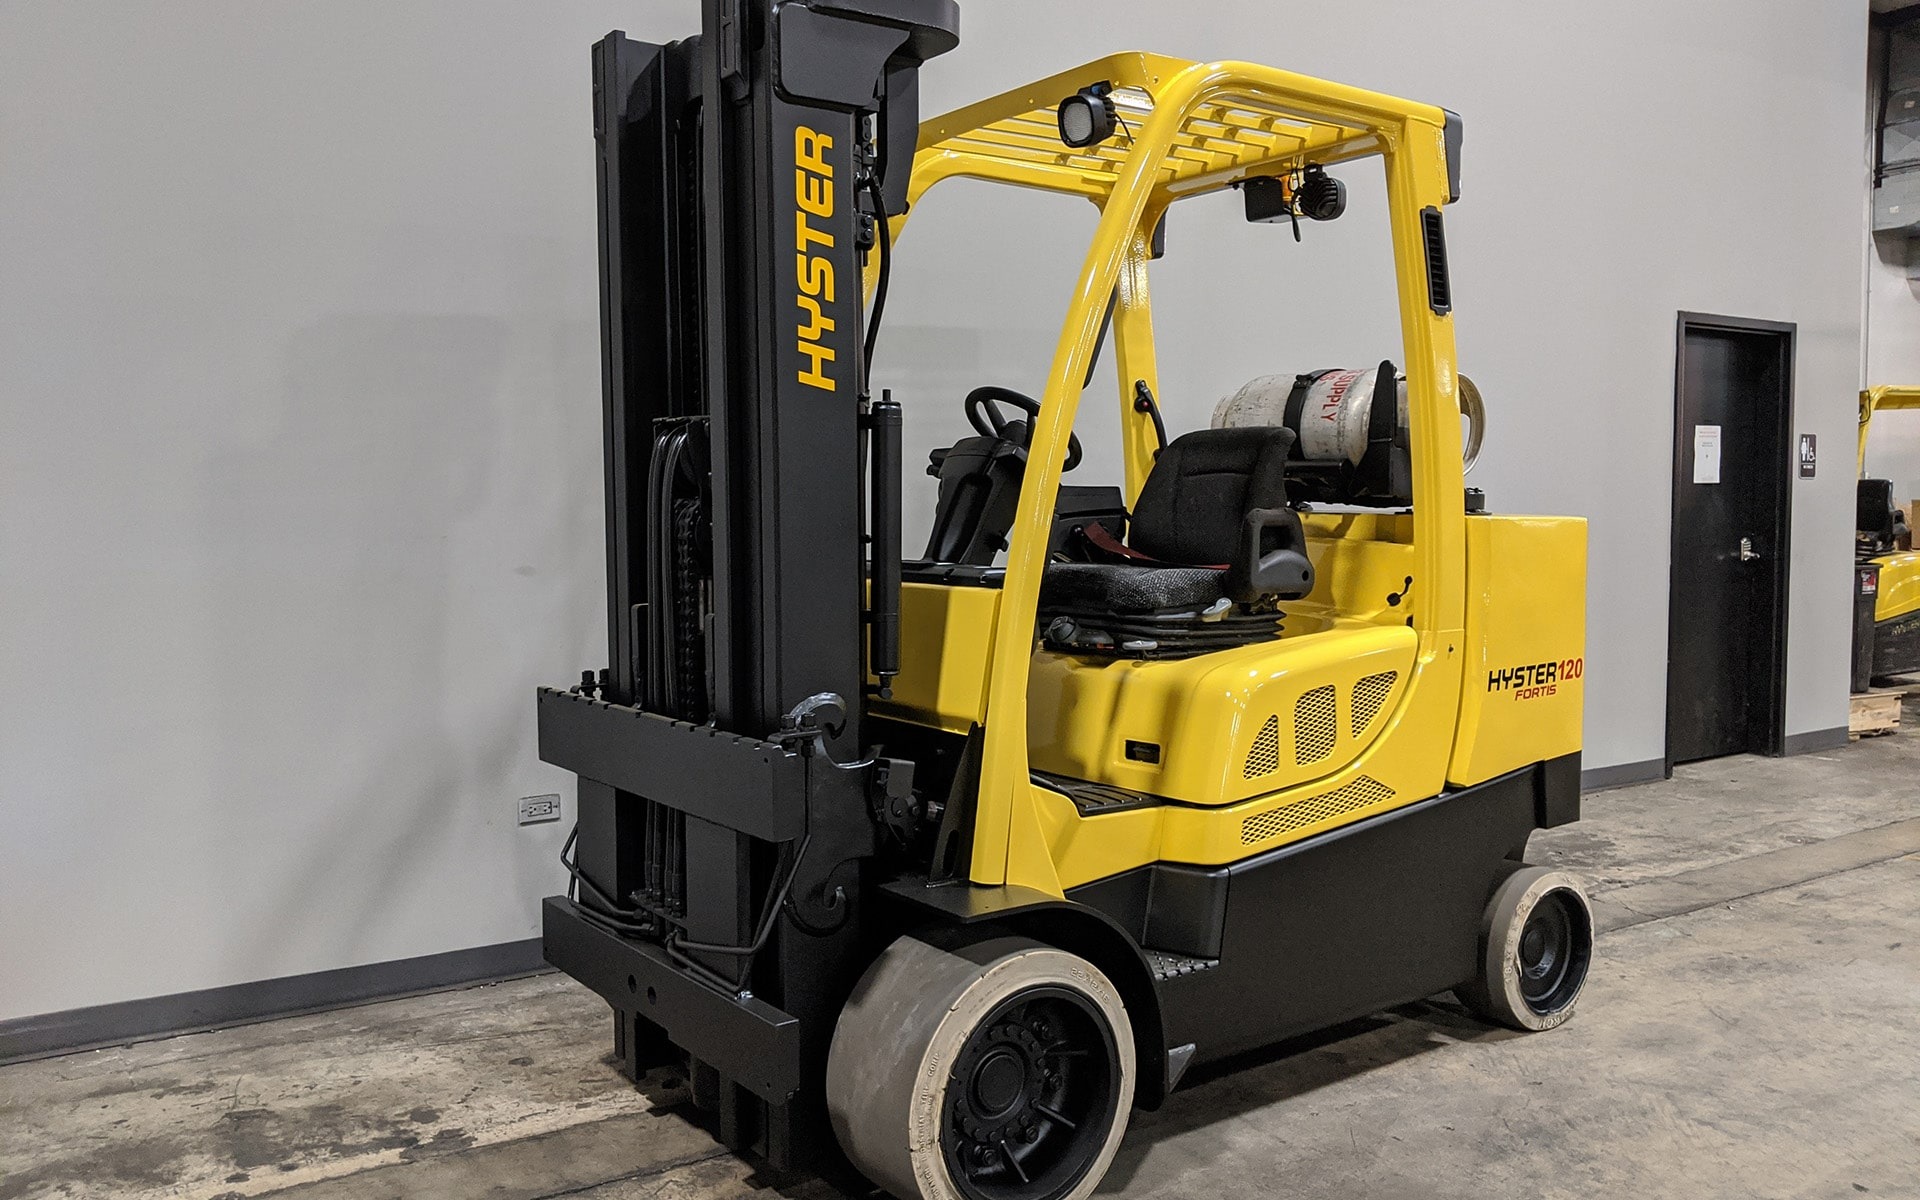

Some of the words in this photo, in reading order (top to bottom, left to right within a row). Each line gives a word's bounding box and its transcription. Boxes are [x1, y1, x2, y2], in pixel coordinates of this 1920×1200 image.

[795, 125, 835, 391] HYSTER
[1320, 374, 1356, 421] SUPPLY
[1487, 661, 1557, 692] HYSTER
[1558, 657, 1584, 681] 120
[1514, 684, 1557, 701] FORTIS
